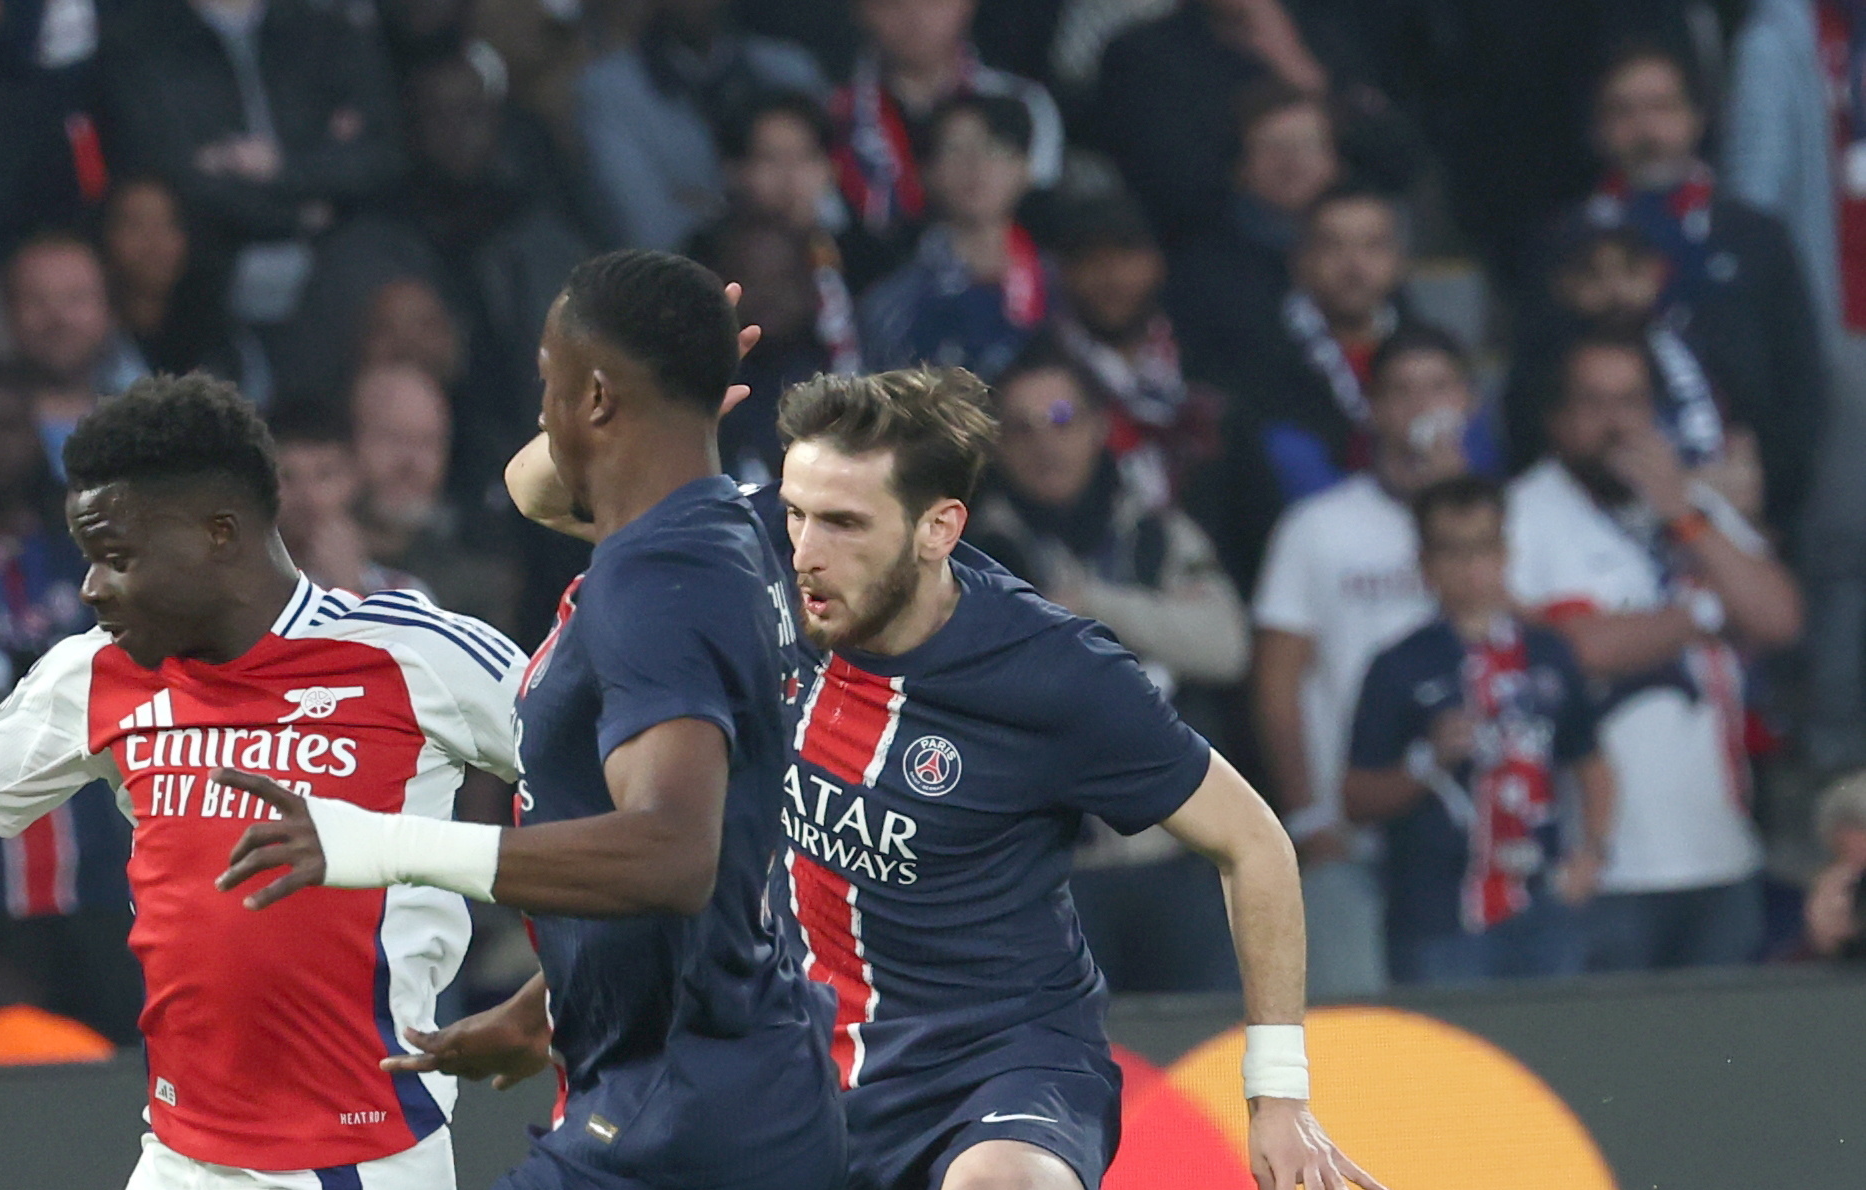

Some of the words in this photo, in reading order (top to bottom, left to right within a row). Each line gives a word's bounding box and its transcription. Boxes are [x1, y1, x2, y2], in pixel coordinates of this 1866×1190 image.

[125, 725, 358, 777] Emirates
[920, 739, 957, 761] PARIS
[150, 773, 196, 817] FLY
[783, 763, 919, 860] ATAR
[780, 806, 918, 885] AIRWAYS
